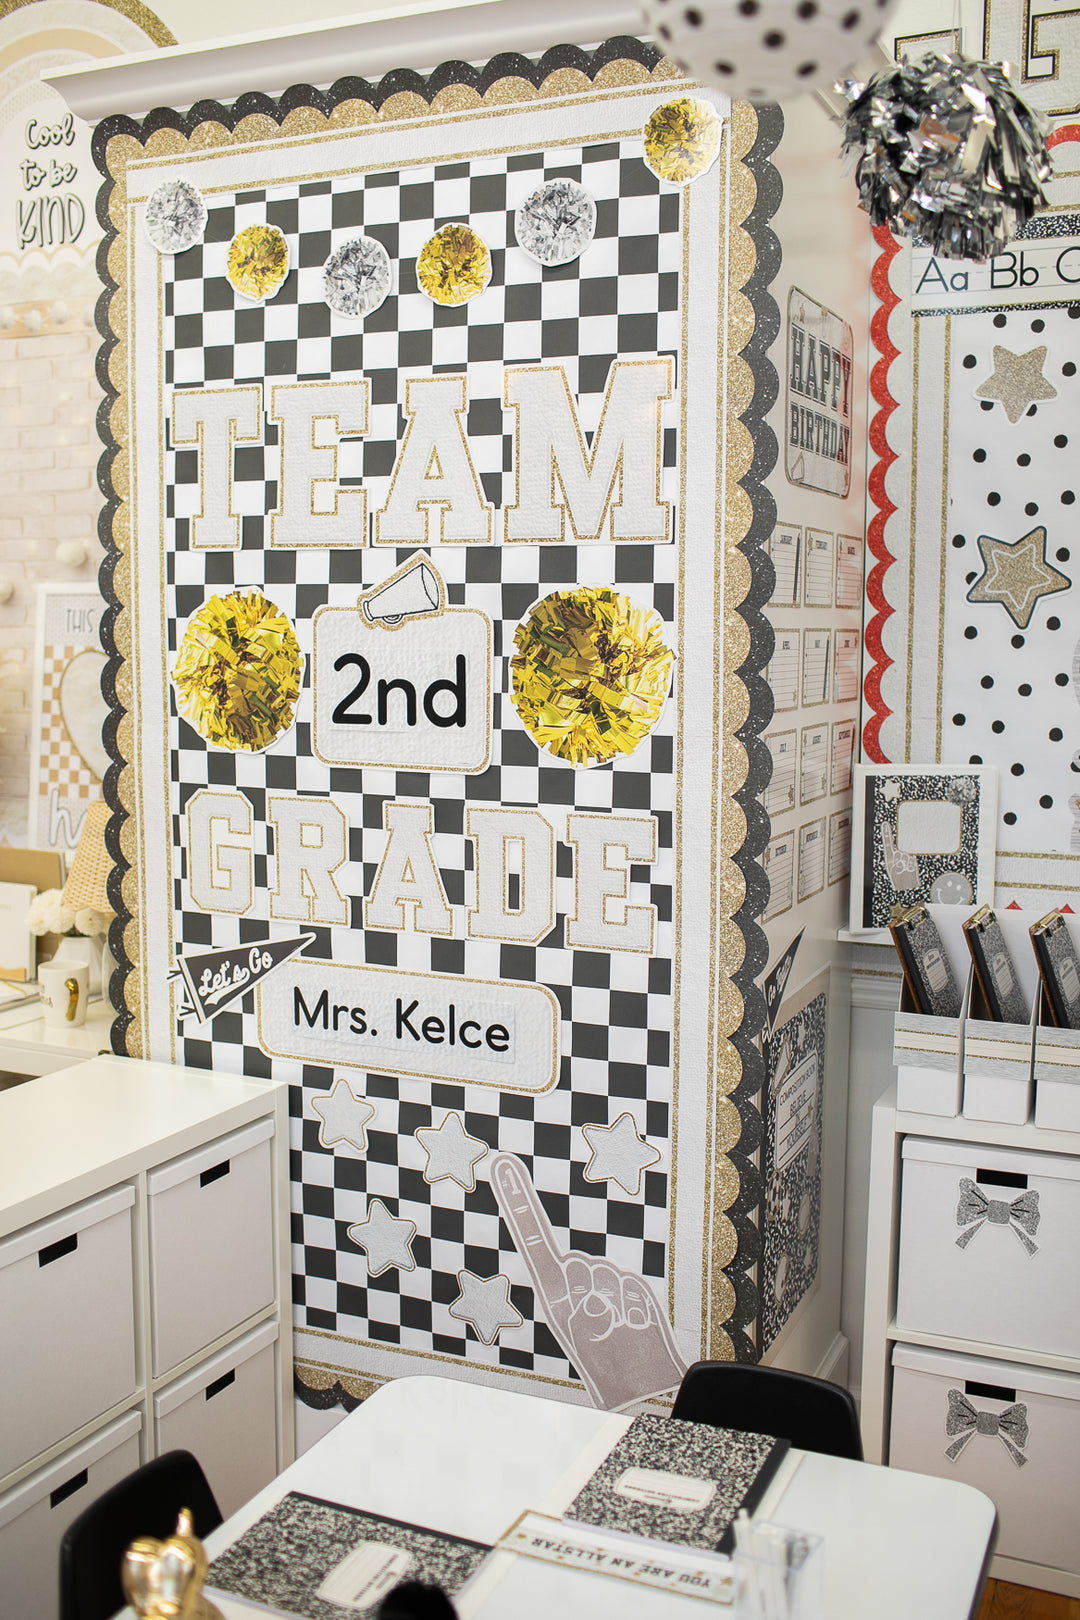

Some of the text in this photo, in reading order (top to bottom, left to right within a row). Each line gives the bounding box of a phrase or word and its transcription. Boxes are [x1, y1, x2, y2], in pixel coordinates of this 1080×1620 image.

[25, 112, 75, 149] Cool
[20, 158, 77, 190] to be
[16, 192, 85, 249] KIND
[916, 257, 968, 293] Aa
[991, 251, 1039, 289] Bb
[789, 322, 852, 418] HAPPY
[171, 358, 674, 549] TEAM
[789, 400, 850, 466] BIRTHDAY
[66, 608, 95, 634] THIS
[332, 653, 466, 728] 2nd
[186, 790, 658, 955] GRADE
[198, 947, 274, 997] Let's Go
[293, 985, 510, 1053] Mrs. Kelce
[610, 1556, 636, 1569] AN
[638, 1562, 675, 1579] ARE
[678, 1574, 711, 1588] YOU
